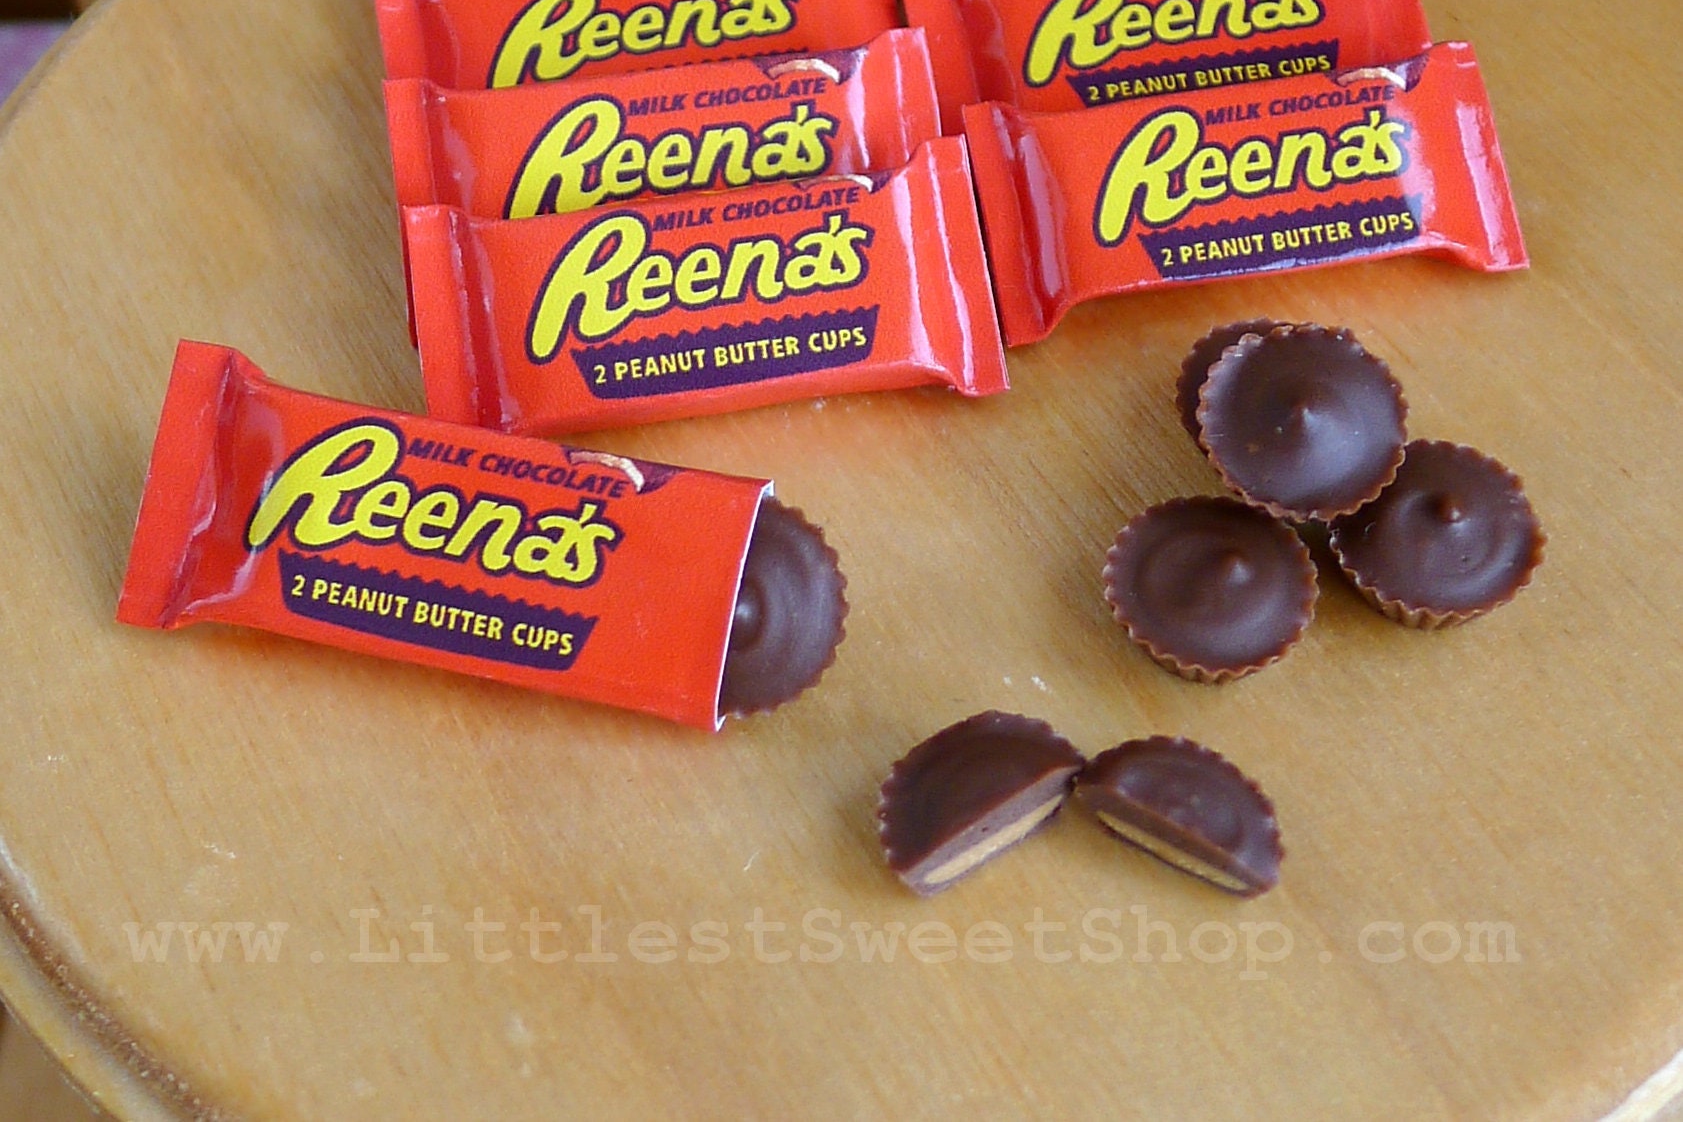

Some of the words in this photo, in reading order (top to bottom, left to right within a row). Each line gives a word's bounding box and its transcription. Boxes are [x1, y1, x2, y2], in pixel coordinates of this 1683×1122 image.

[628, 94, 688, 116] MILK
[694, 77, 827, 108] CHOCOLATE
[1088, 86, 1100, 100] 2
[1106, 75, 1186, 99] PEANUT
[1197, 64, 1271, 87] BUTTER
[1280, 54, 1331, 76] CUPS
[1205, 106, 1261, 126] MILK
[1269, 85, 1396, 117] CHOCOLATE
[507, 102, 835, 220] Reena's
[1098, 109, 1406, 244] Reena's
[653, 207, 716, 232] MILK
[722, 187, 860, 222] CHOCOLATE
[1160, 249, 1174, 267] 2
[1180, 236, 1265, 265] PEANUT
[1272, 224, 1353, 252] BUTTER
[1358, 211, 1415, 240] CUPS
[529, 214, 869, 360] Reena's
[593, 364, 606, 384] 2
[614, 349, 705, 382] PEANUT
[715, 337, 799, 368] BUTTER
[808, 326, 867, 352] CUPS
[406, 437, 479, 468] MILK
[478, 452, 629, 499] CHOCOLATE
[247, 423, 616, 584] Reena's
[291, 575, 303, 597] 2
[311, 577, 409, 619] PEANUT
[413, 600, 503, 640] BUTTER
[512, 622, 575, 656] CUPS
